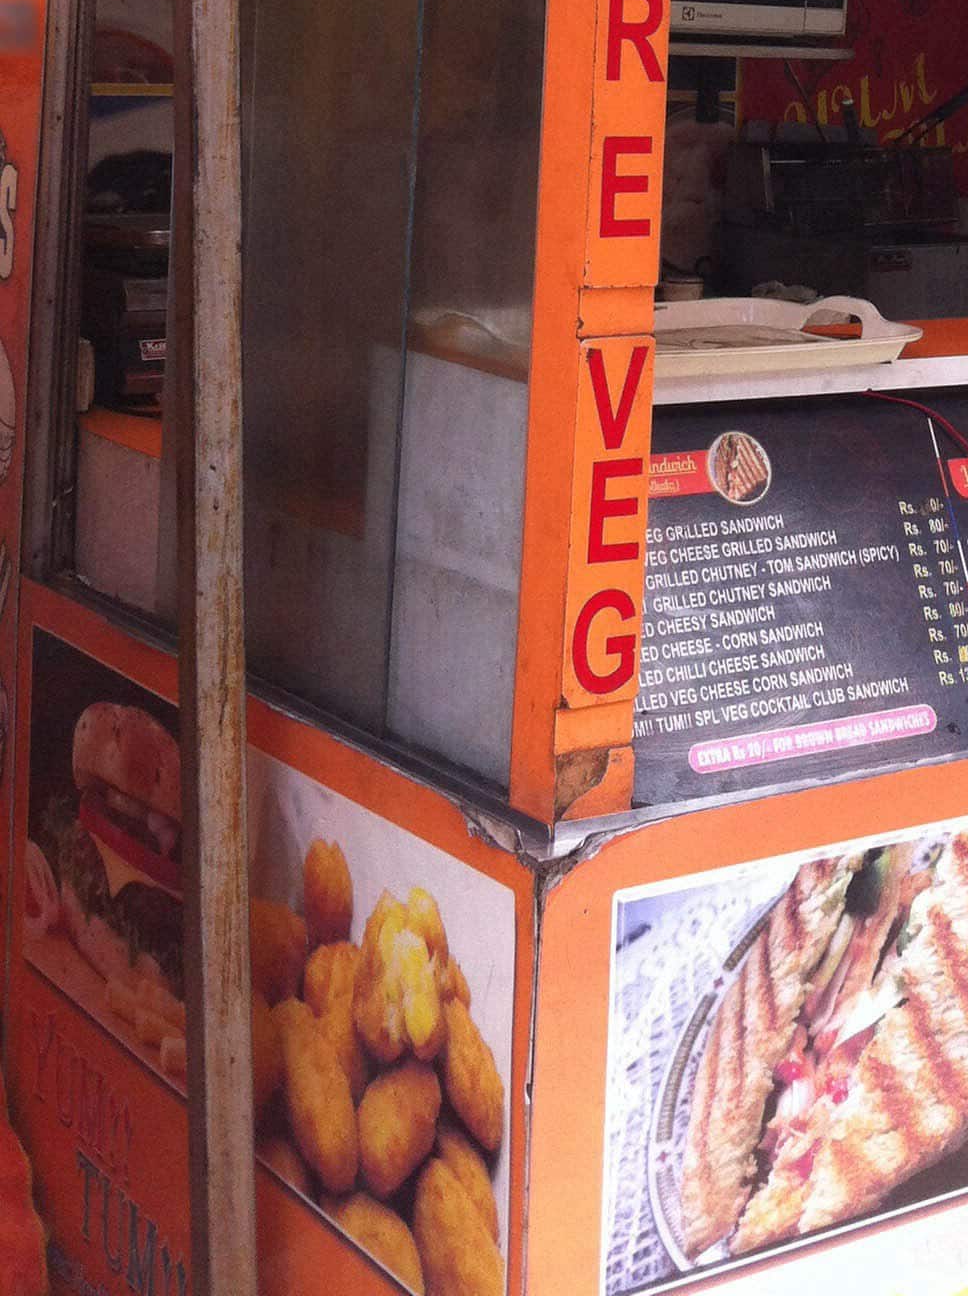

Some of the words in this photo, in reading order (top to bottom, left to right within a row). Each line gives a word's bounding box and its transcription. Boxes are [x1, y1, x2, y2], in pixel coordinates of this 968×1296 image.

[650, 455, 697, 475] ndwich
[571, 345, 649, 696] VEG
[645, 527, 664, 544] EG
[720, 513, 785, 536] SANDWICH
[670, 543, 721, 565] CHEESE
[722, 537, 773, 558] GRILLED
[775, 529, 838, 550] SANDWICH
[645, 568, 699, 591] GRILLED
[702, 562, 758, 584] CHUTNEY
[767, 558, 794, 576] TOM
[795, 549, 858, 571] SANDWICH
[859, 544, 900, 566] (SPICY)
[652, 591, 707, 613] GRILLED
[709, 583, 767, 606] CHUTNEY
[768, 575, 832, 598] SANDWICH
[657, 615, 708, 637] CHEESY
[710, 604, 776, 629] SANDWICH
[662, 636, 714, 660] CHEESE
[721, 631, 759, 651] CORN
[759, 621, 824, 645] SANDWICH
[666, 662, 708, 685] CHILLI
[709, 654, 759, 677] CHEESE
[761, 644, 825, 668] SANDWICH
[671, 687, 698, 707] VEG
[700, 679, 751, 702] CHEESE
[752, 673, 789, 693] CORN
[789, 662, 854, 687] SANDWICH
[694, 708, 721, 728] SPL
[721, 703, 749, 723] VEG
[750, 692, 812, 718] COCKTAIL
[813, 686, 846, 708] CLUB
[847, 675, 909, 702] SANDWICH
